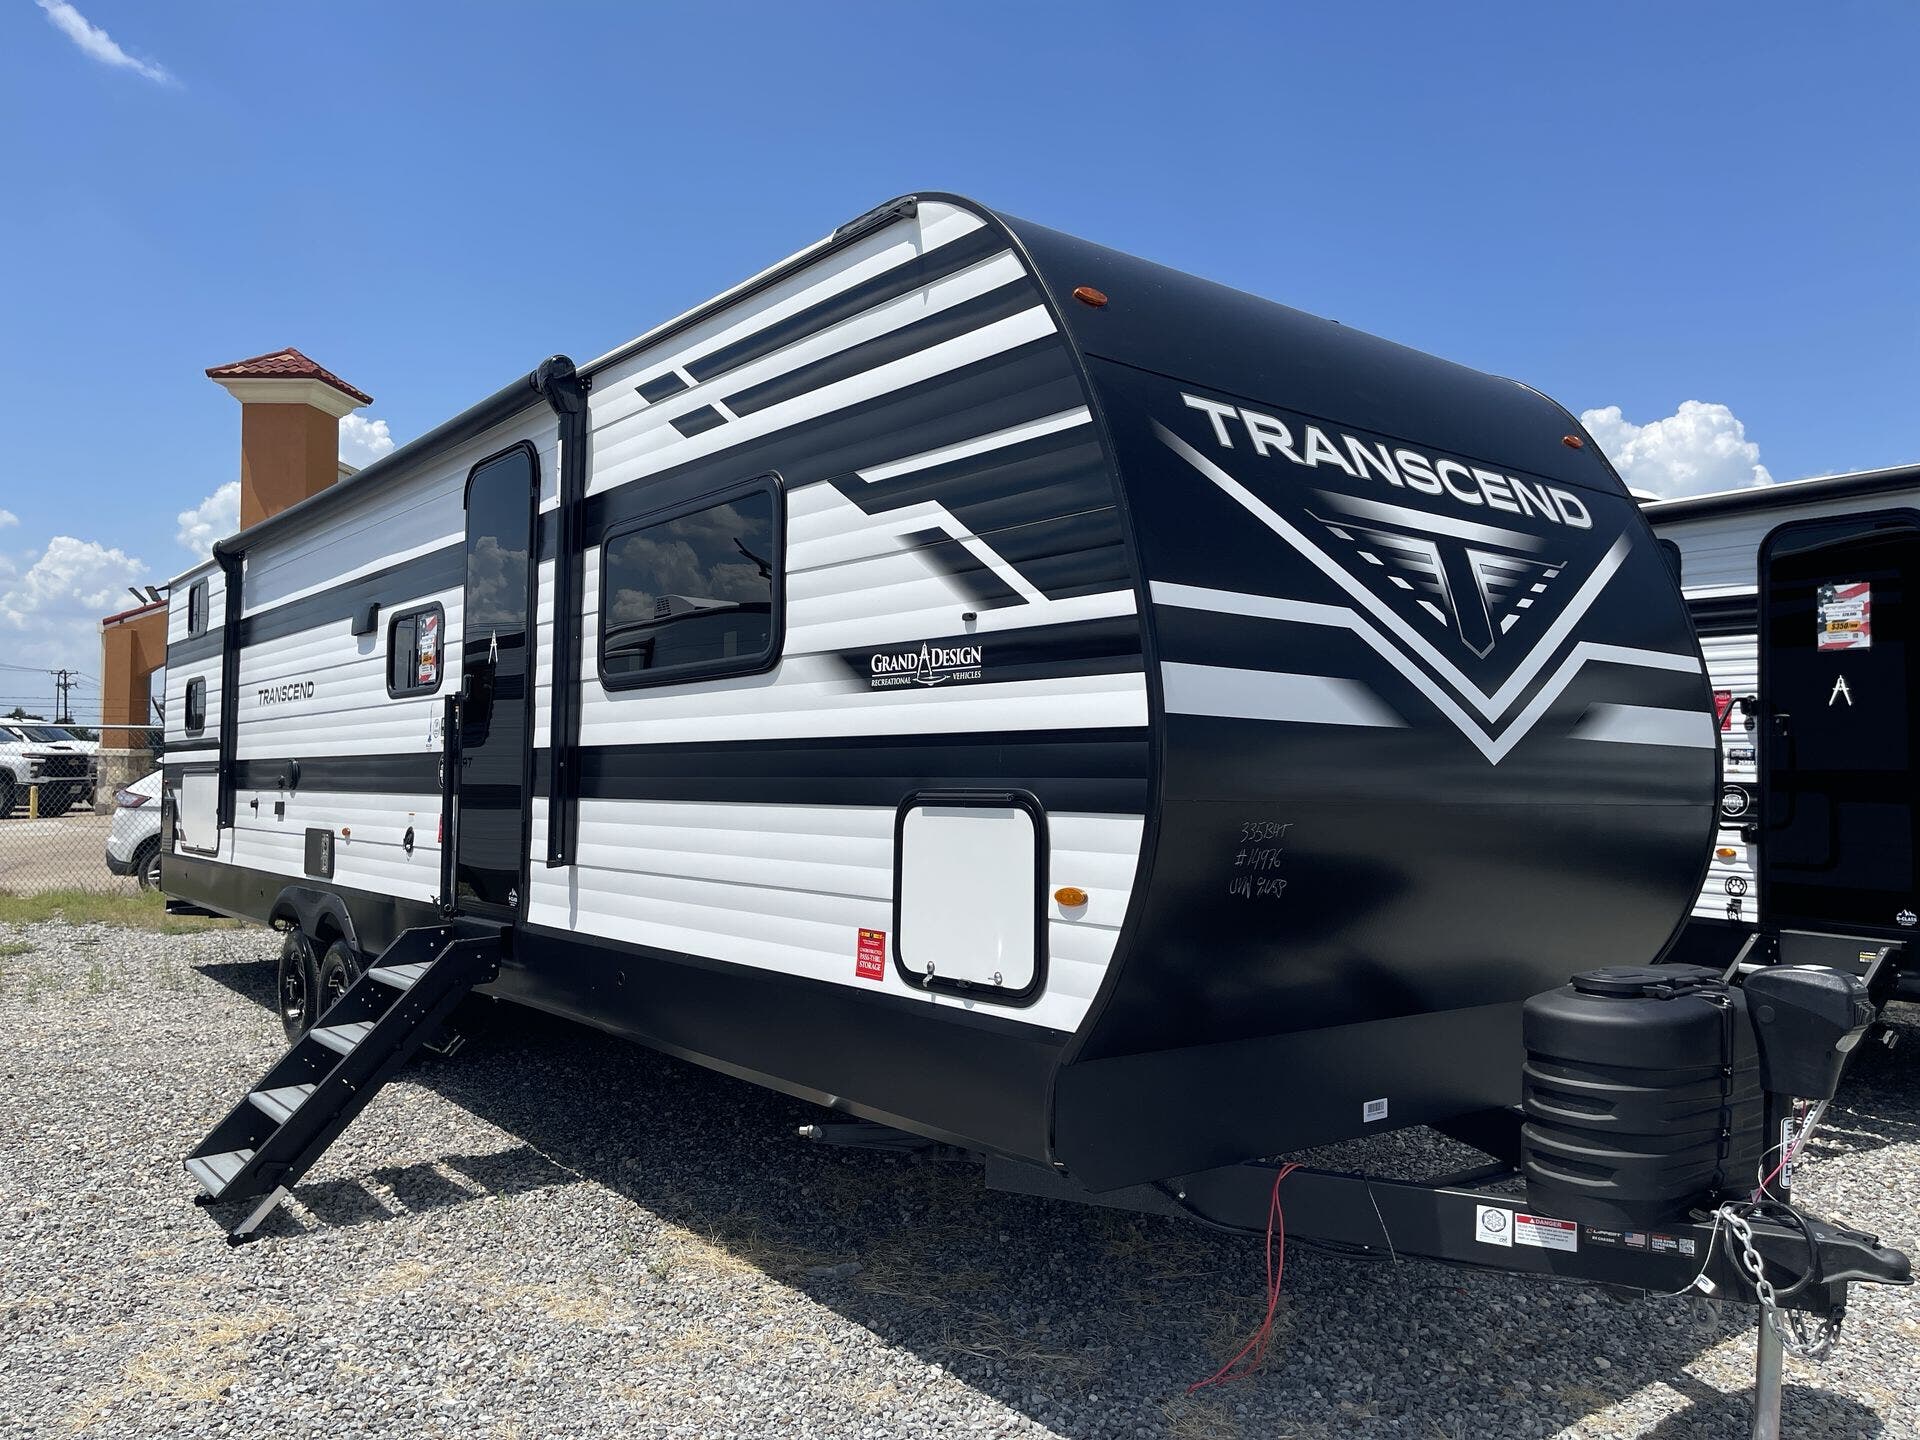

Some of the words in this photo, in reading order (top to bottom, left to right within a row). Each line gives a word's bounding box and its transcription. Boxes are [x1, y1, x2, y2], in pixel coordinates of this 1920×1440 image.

[1180, 392, 1593, 530] TRANSCEND
[871, 654, 918, 673] GRAND
[931, 645, 982, 668] DESIGN
[871, 677, 912, 687] RECREATIONAL
[953, 670, 981, 680] VEHICLES
[258, 681, 315, 706] TRANSCEND
[859, 960, 881, 971] STORAGE
[1535, 1219, 1562, 1228] DANGER
